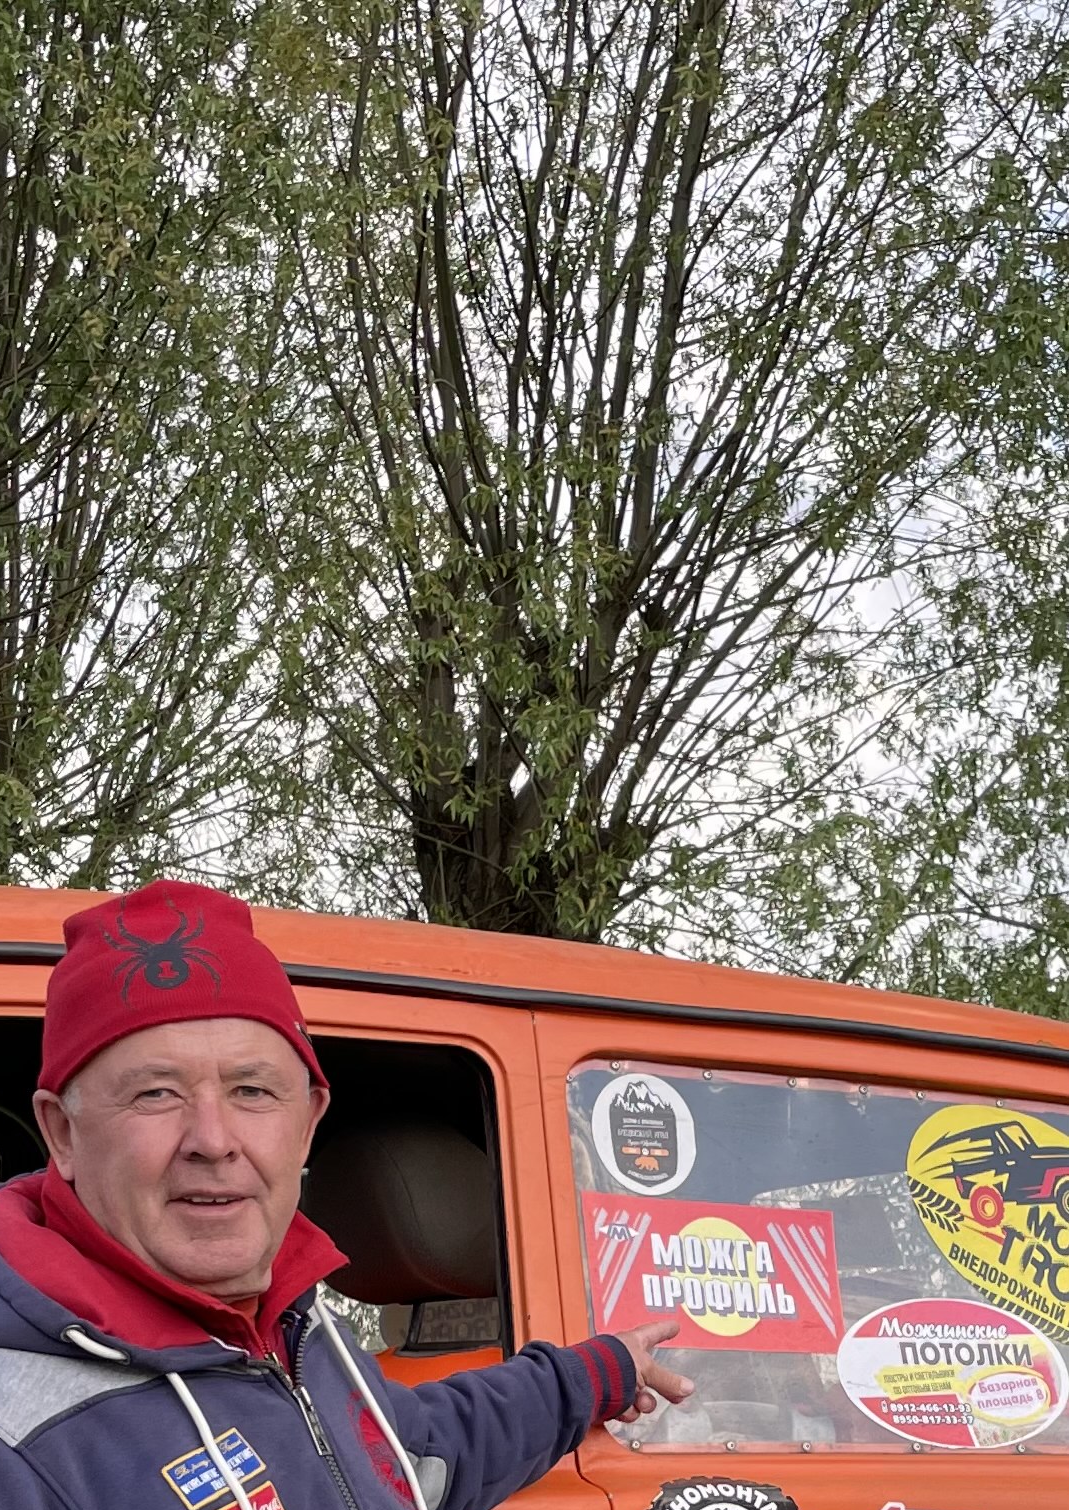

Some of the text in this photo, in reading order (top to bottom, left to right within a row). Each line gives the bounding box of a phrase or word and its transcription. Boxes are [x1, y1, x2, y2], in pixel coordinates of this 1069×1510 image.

[650, 1232, 777, 1277] МОЖГА
[948, 1242, 1066, 1324] ВНЕДОРОЖНЫЙ
[641, 1273, 797, 1321] ПРОФИЛЬ
[878, 1317, 1008, 1340] Можгинские
[898, 1341, 1033, 1366] ПОТОЛКИ
[978, 1378, 1038, 1393] Базарная
[977, 1394, 1033, 1409] площадь
